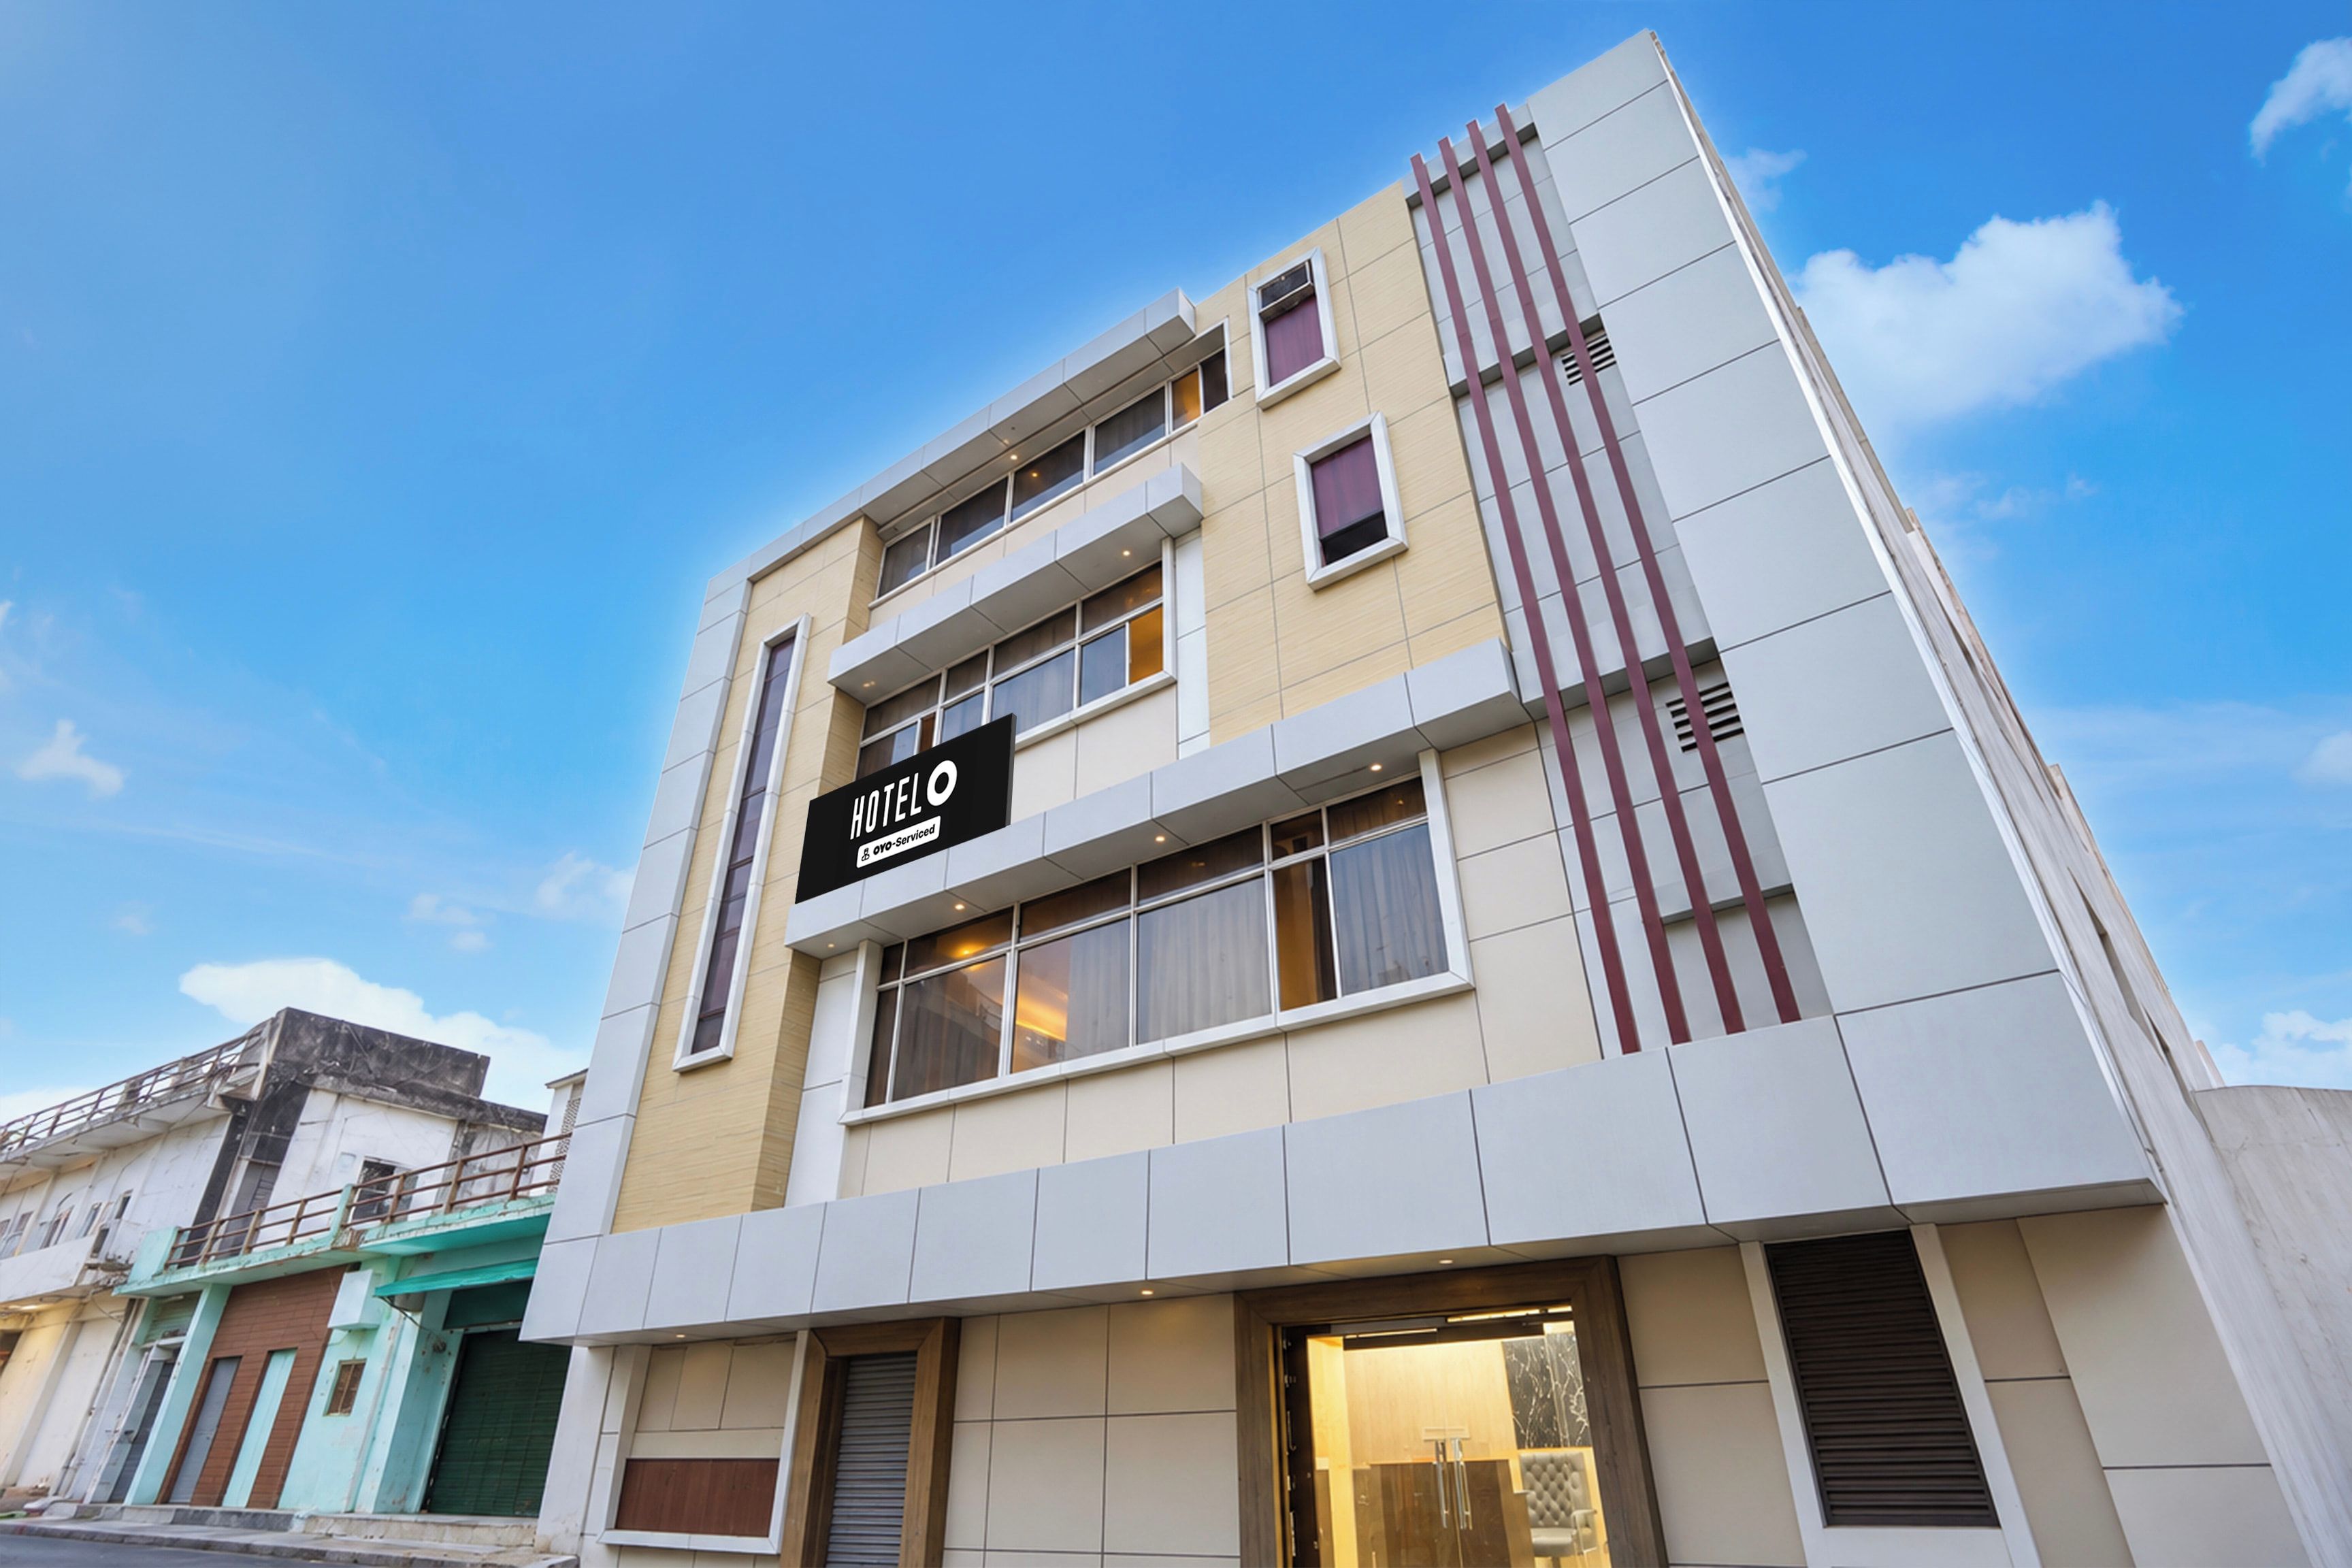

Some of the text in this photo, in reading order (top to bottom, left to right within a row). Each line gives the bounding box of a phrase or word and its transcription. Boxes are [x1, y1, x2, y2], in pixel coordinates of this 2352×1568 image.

[850, 760, 958, 840] HOTEL O
[873, 824, 935, 855] OYO-Serviced
